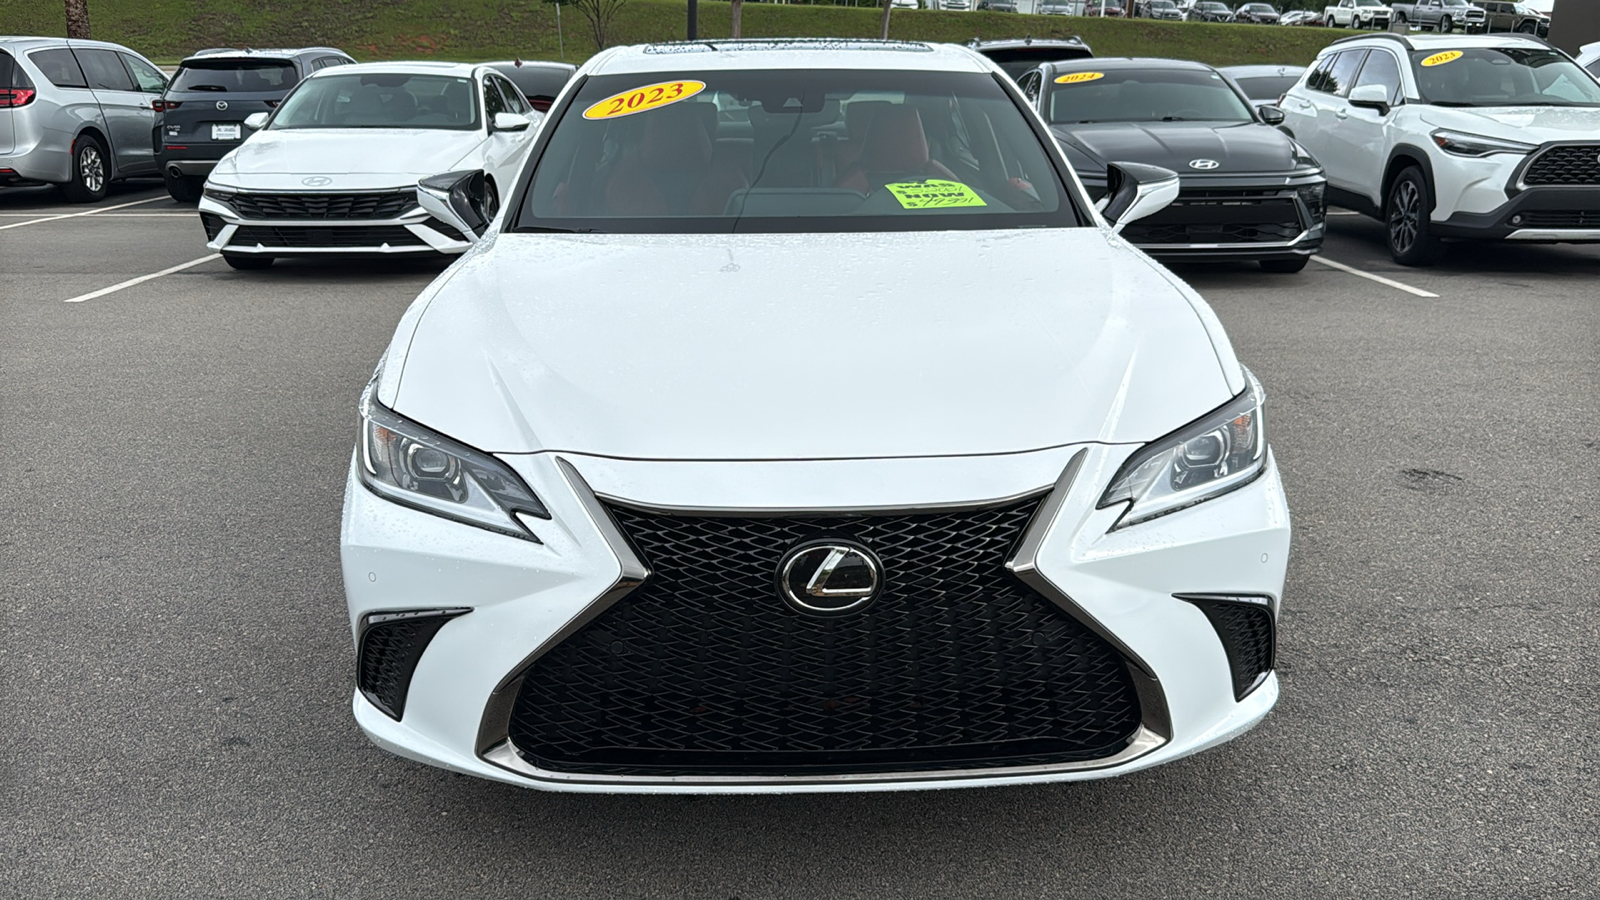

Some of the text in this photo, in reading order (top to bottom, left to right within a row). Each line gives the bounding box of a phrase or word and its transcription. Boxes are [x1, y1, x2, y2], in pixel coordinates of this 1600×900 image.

[1429, 51, 1456, 64] 2023
[1063, 72, 1096, 83] 2024
[607, 83, 684, 115] 2023
